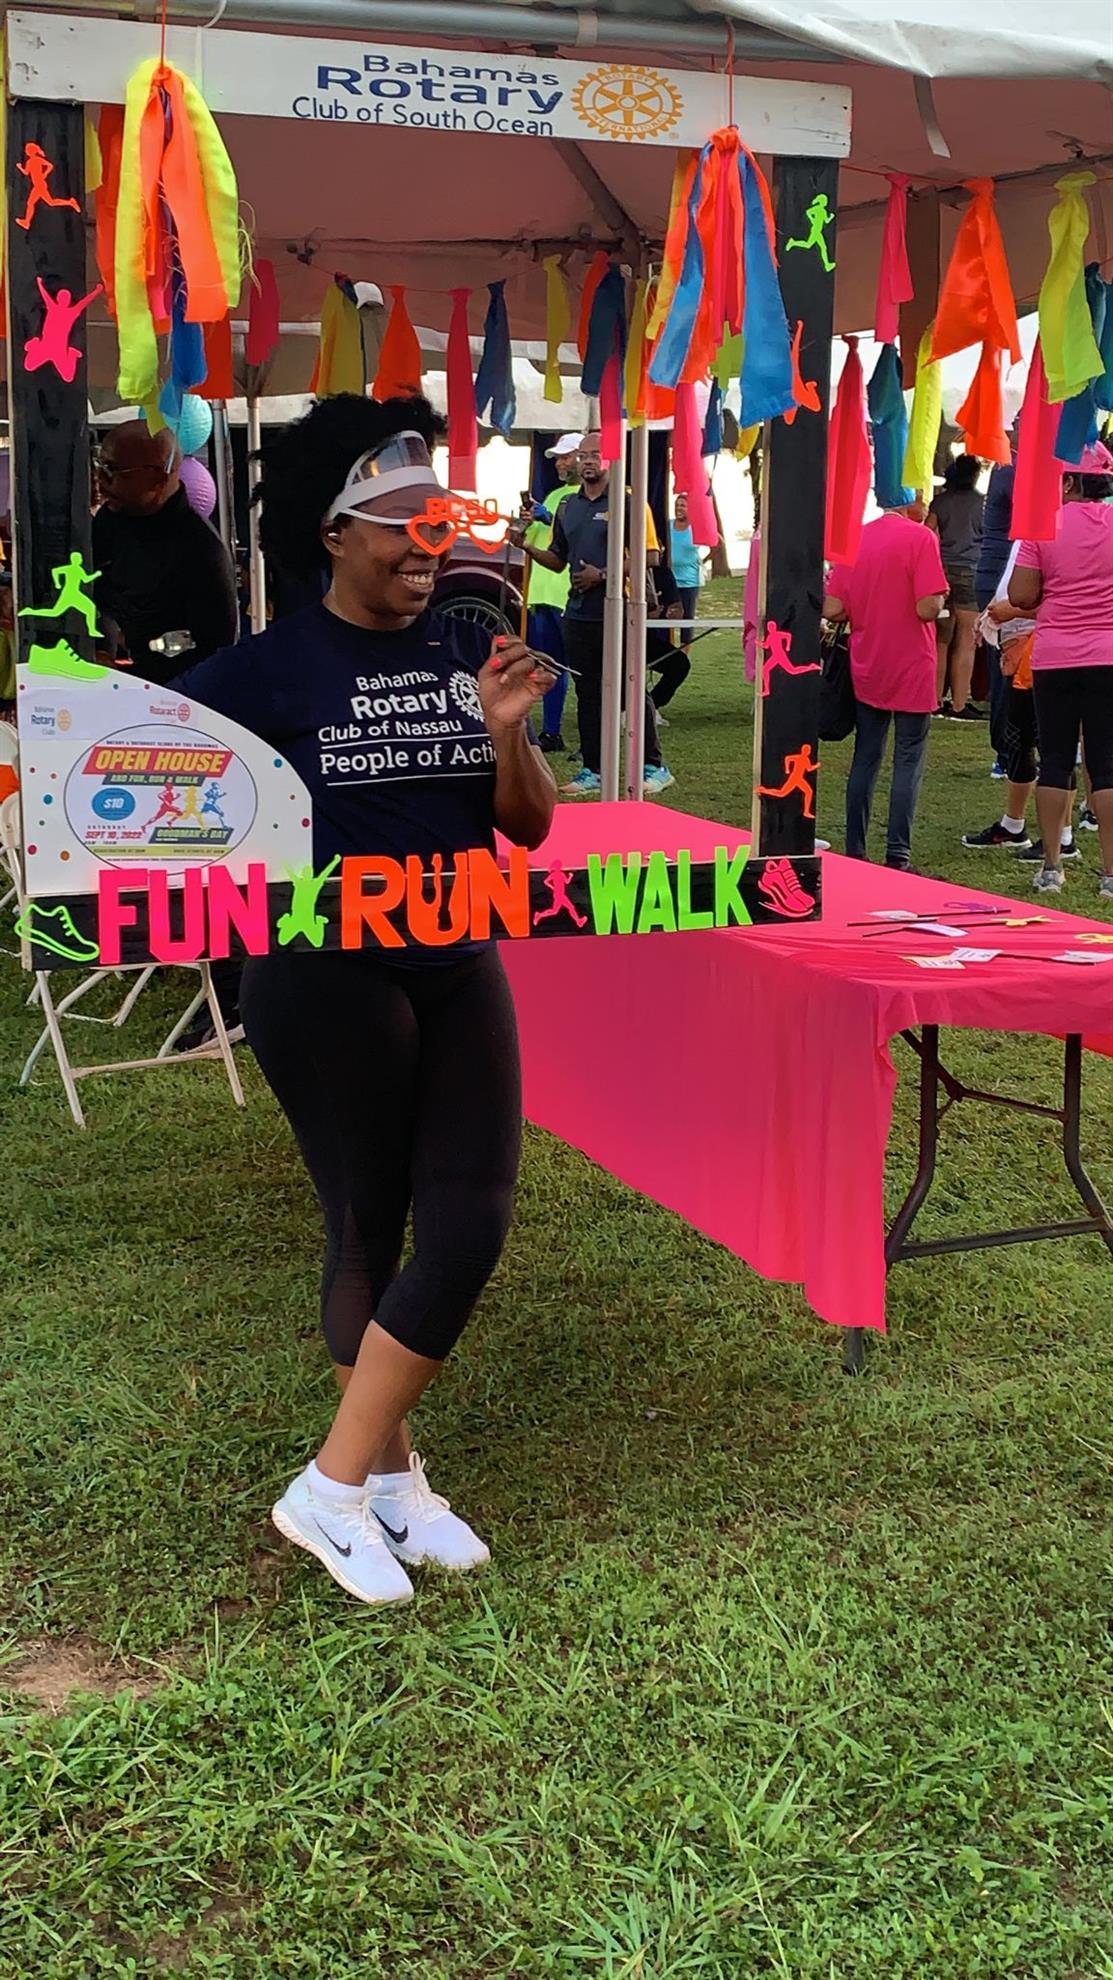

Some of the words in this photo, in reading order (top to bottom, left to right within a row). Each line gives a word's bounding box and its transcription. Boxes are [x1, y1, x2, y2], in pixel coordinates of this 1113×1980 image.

[363, 54, 560, 86] Bahamas
[317, 65, 564, 115] Rotary
[292, 96, 348, 121] Club
[356, 103, 384, 122] of
[392, 104, 467, 130] South
[473, 110, 554, 137] Ocean
[355, 670, 439, 692] Bahamas
[350, 688, 448, 720] Rotary
[31, 713, 56, 727] Rotary
[318, 723, 362, 743] Club
[367, 720, 390, 737] of
[395, 719, 463, 736] Nassau
[95, 749, 152, 771] OPEN
[152, 751, 225, 773] HOUSE
[319, 746, 409, 776] People
[417, 744, 442, 766] of
[450, 741, 498, 766] Acti
[175, 776, 199, 785] WALK
[103, 797, 125, 809] $10
[85, 831, 106, 839] SEPT
[120, 831, 142, 840] 2022
[209, 830, 229, 840] BAY
[98, 863, 271, 965] FUN
[340, 848, 530, 951] RUN
[587, 845, 754, 936] WALK
